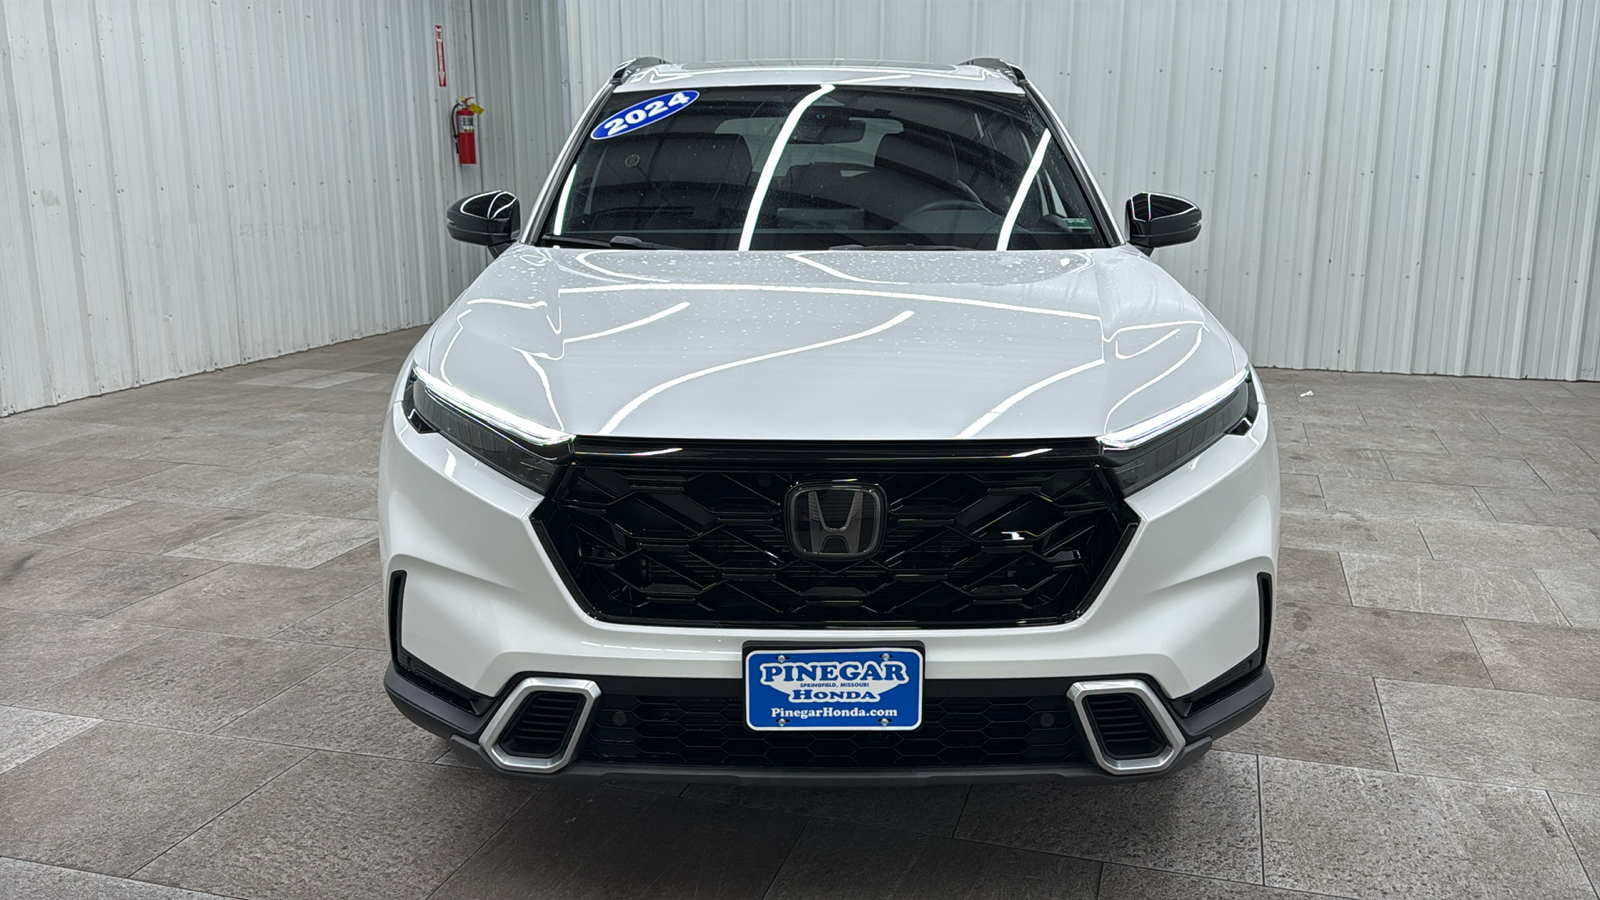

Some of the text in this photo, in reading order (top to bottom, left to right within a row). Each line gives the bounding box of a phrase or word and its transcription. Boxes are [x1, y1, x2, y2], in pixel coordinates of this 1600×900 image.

[604, 92, 690, 136] 2024
[763, 664, 905, 682] PINEGAR
[792, 689, 877, 700] HONDA
[771, 707, 898, 719] PinegarHonda.com
